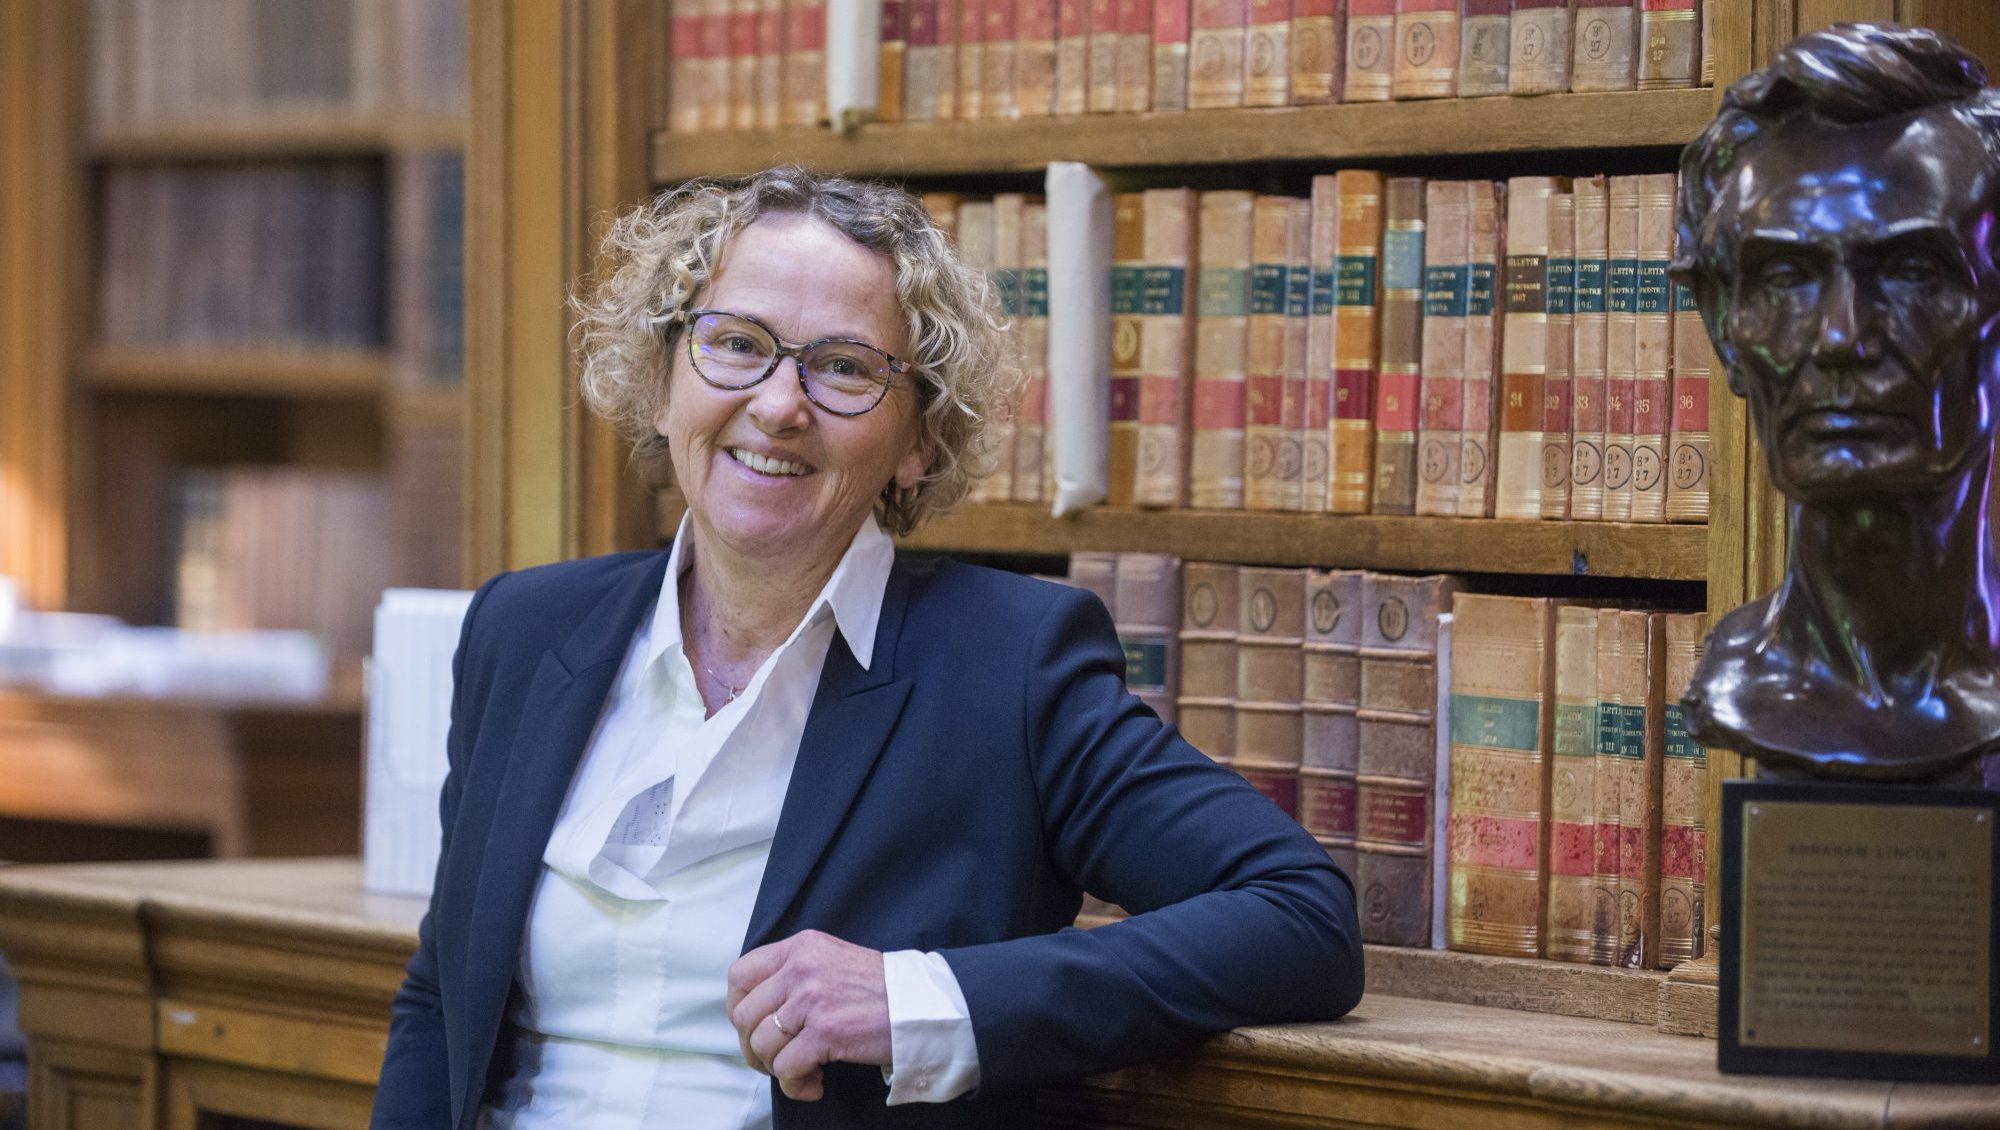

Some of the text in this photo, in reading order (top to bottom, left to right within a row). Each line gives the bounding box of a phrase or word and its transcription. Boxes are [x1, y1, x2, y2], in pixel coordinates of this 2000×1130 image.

[1509, 392, 1522, 407] 31
[1546, 395, 1559, 410] 32
[1576, 395, 1588, 409] 33
[1608, 396, 1622, 411] 34
[1636, 399, 1650, 413] 35
[1680, 395, 1693, 410] 36
[1576, 465, 1589, 477] 27
[1607, 467, 1620, 479] 27
[1636, 469, 1649, 481] 27
[1676, 744, 1685, 754] III
[1596, 841, 1605, 856] 2
[1625, 843, 1632, 857] 3
[1669, 843, 1678, 858] 4
[1696, 848, 1704, 864] 5
